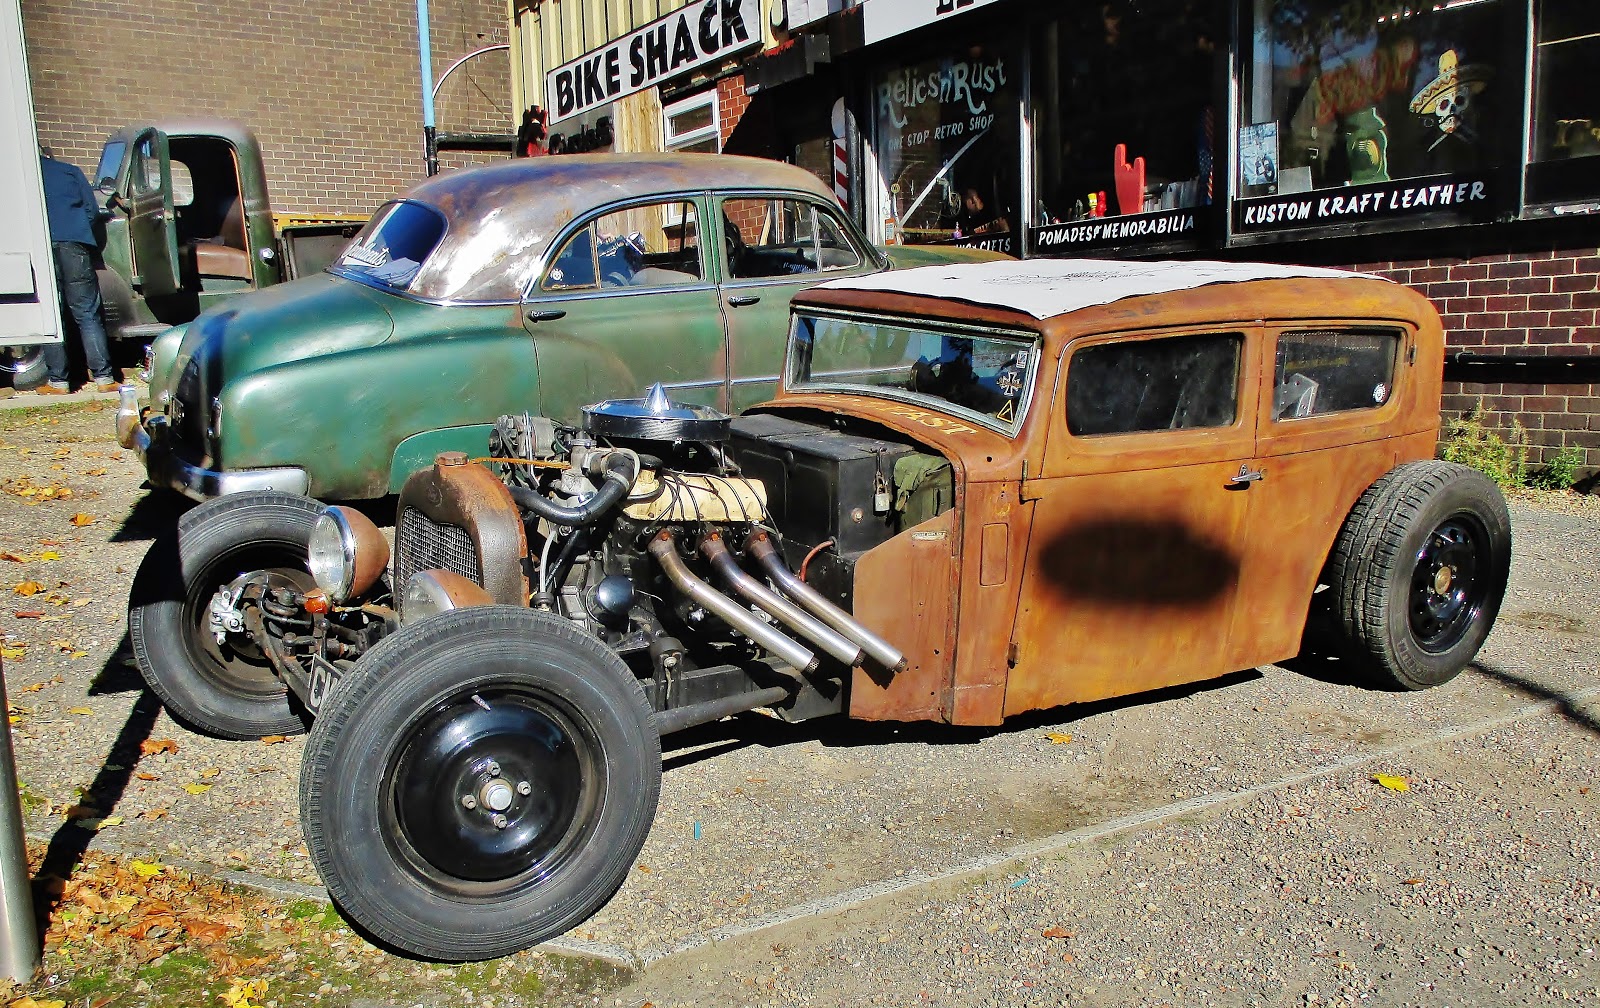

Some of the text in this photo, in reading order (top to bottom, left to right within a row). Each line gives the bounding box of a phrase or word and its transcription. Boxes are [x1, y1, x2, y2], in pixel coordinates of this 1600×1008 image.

[555, 0, 749, 117] BIKE SHACK
[952, 57, 1006, 114] Rust
[907, 130, 930, 147] STOP
[934, 122, 964, 140] RETRO
[969, 114, 994, 131] SHOP
[1245, 181, 1487, 225] KUSTOM KRAFT LEATHER
[1038, 225, 1092, 246] POMADES
[1102, 215, 1194, 239] MEMORABILIA
